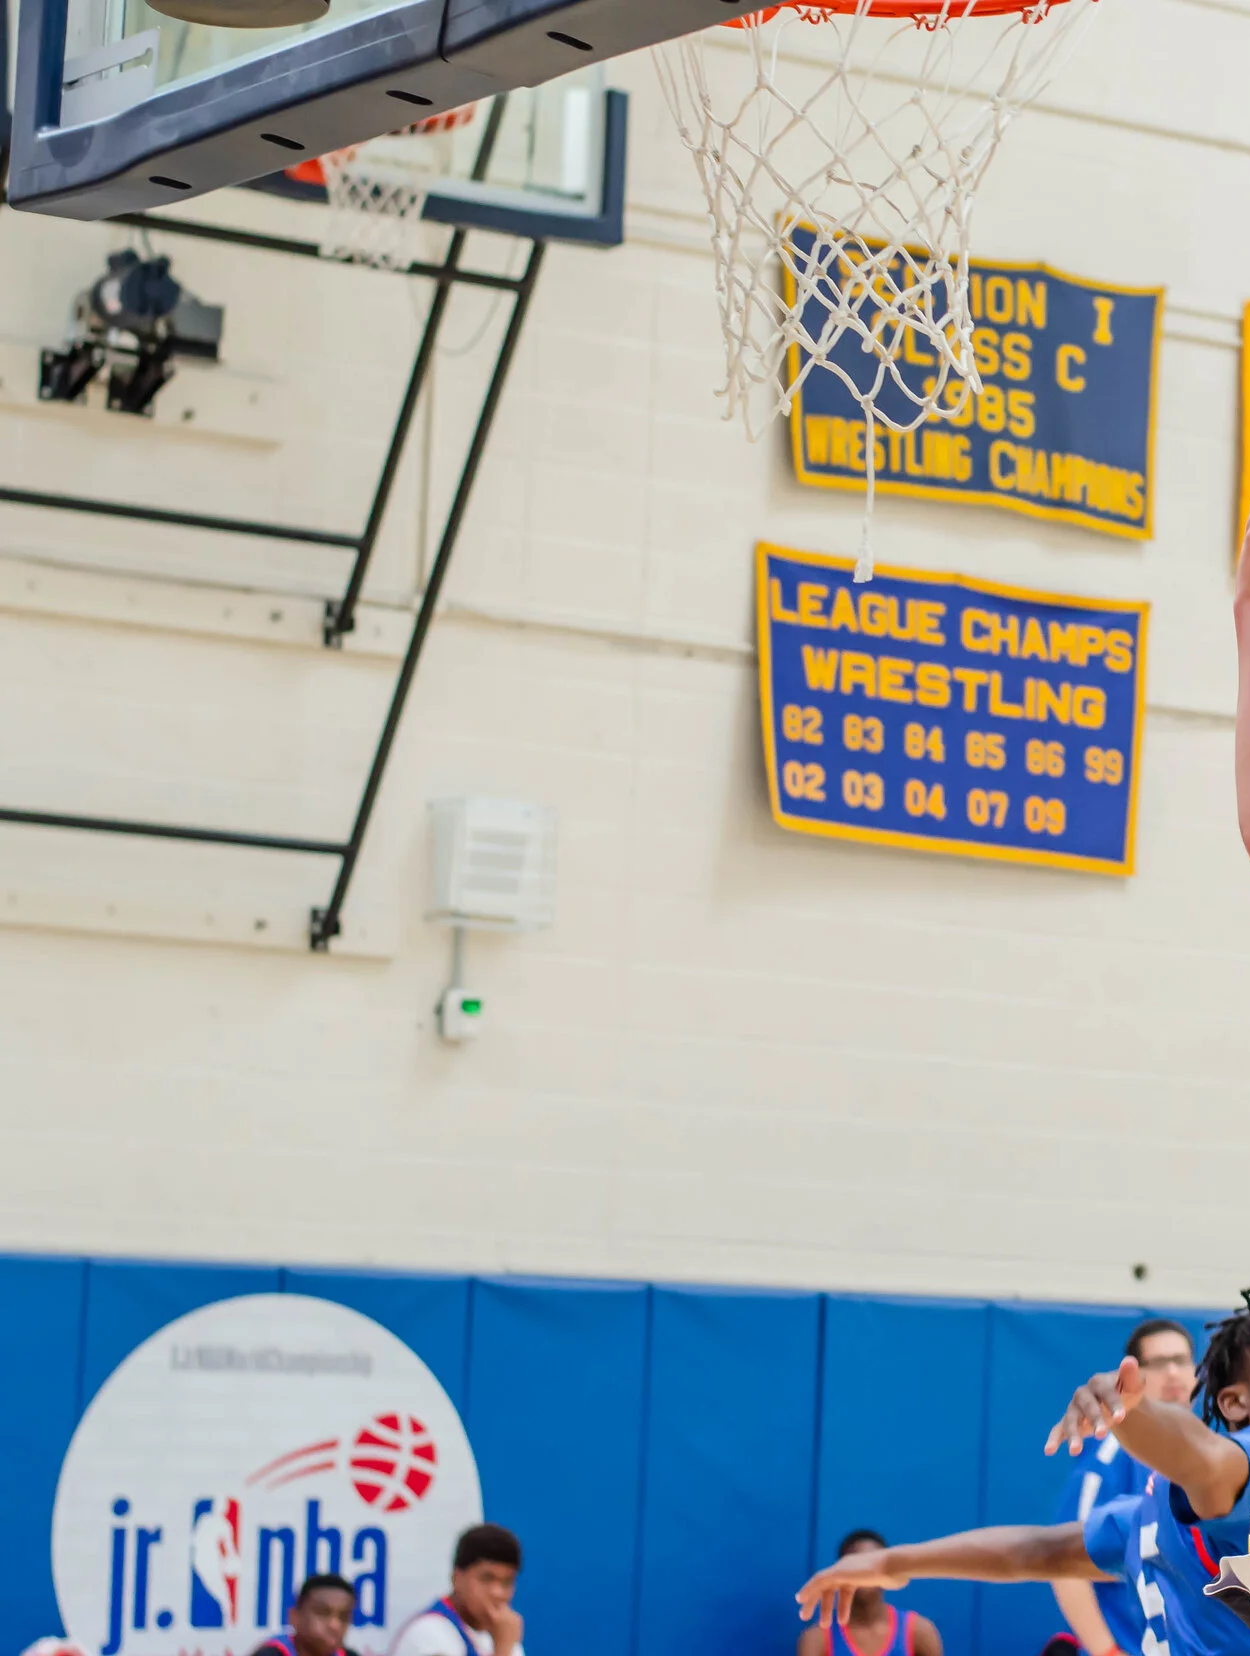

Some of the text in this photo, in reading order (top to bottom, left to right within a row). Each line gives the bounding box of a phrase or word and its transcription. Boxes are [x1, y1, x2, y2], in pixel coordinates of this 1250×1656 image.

[922, 376, 1036, 439] 1985
[1055, 343, 1087, 393] C
[804, 413, 1146, 521] WRESTLING CHAMPIONS
[769, 577, 1134, 674] LEAGUE CHAMPS
[801, 644, 1108, 730] WRESTLING
[782, 703, 1124, 786] 82 83 84 85 86 99
[783, 760, 1067, 837] 02 03 04 07 09
[101, 1496, 389, 1656] jr. nba
